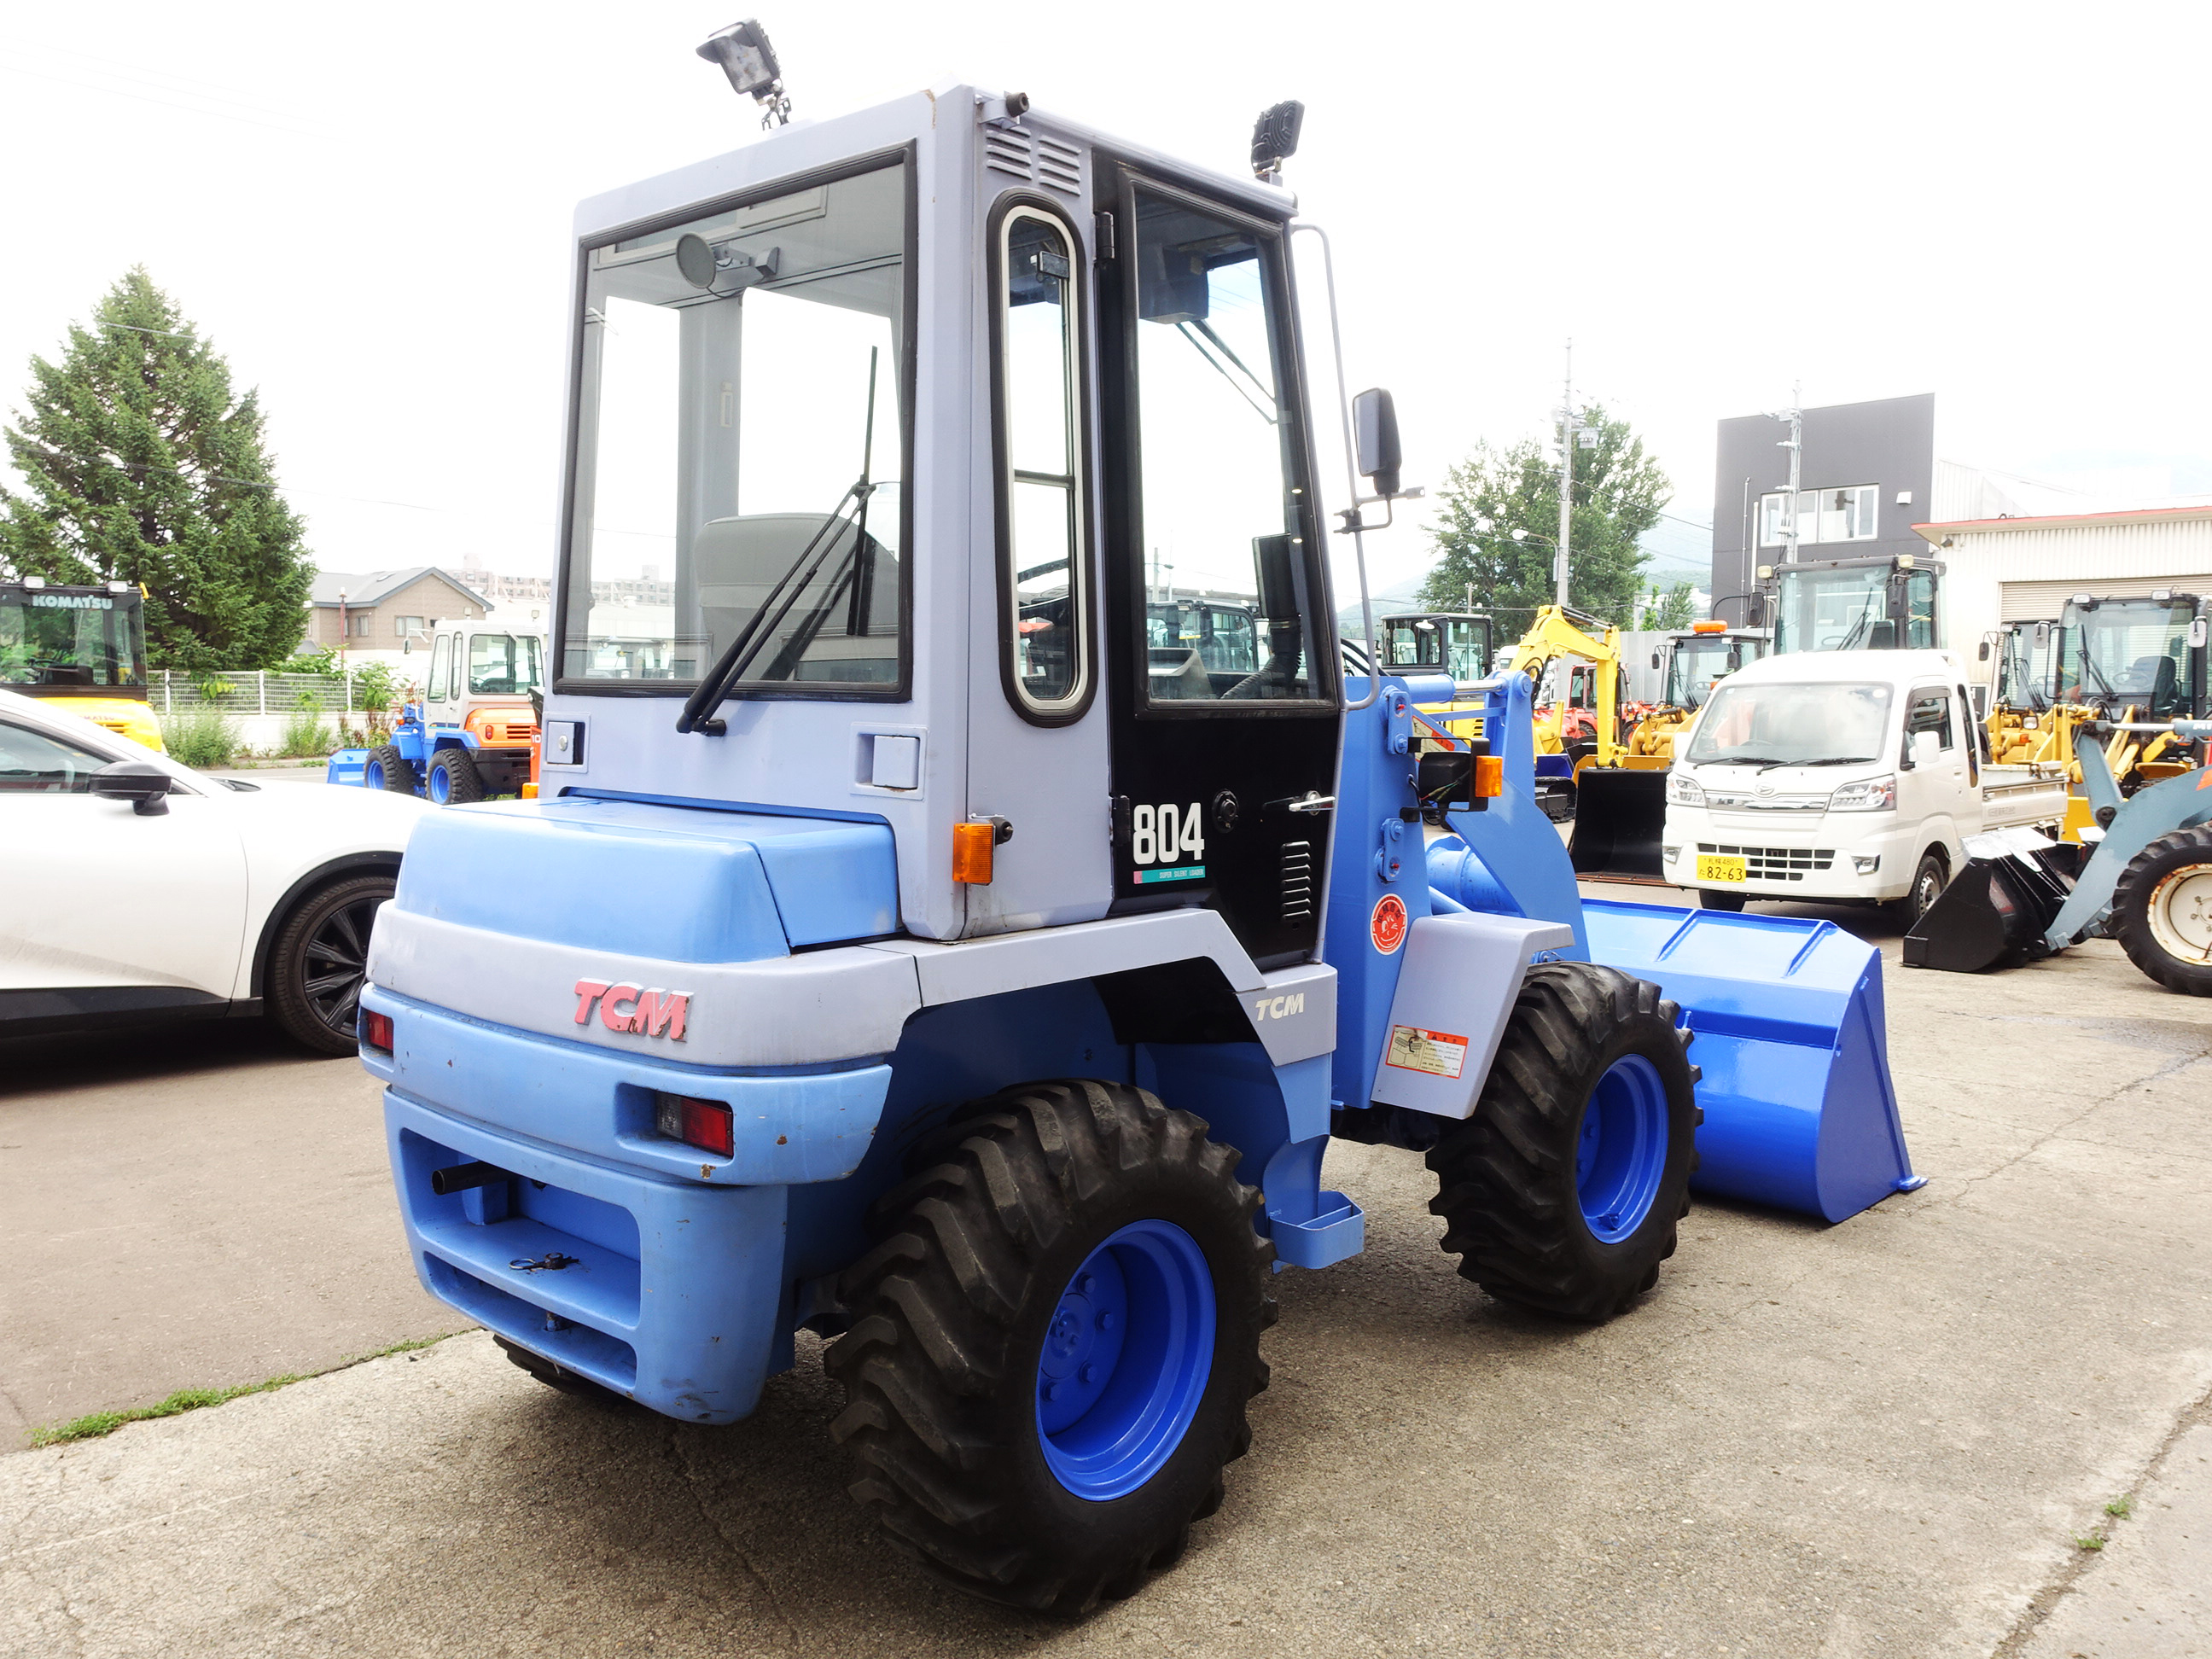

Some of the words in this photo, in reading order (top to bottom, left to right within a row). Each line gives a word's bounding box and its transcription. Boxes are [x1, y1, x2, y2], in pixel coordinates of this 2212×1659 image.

[32, 595, 113, 610] KOMATSU
[1133, 802, 1205, 864] 804
[1159, 870, 1173, 879] SUPER
[1707, 865, 1743, 881] 82-63
[573, 978, 694, 1042] TCM
[1255, 992, 1305, 1022] TCM
